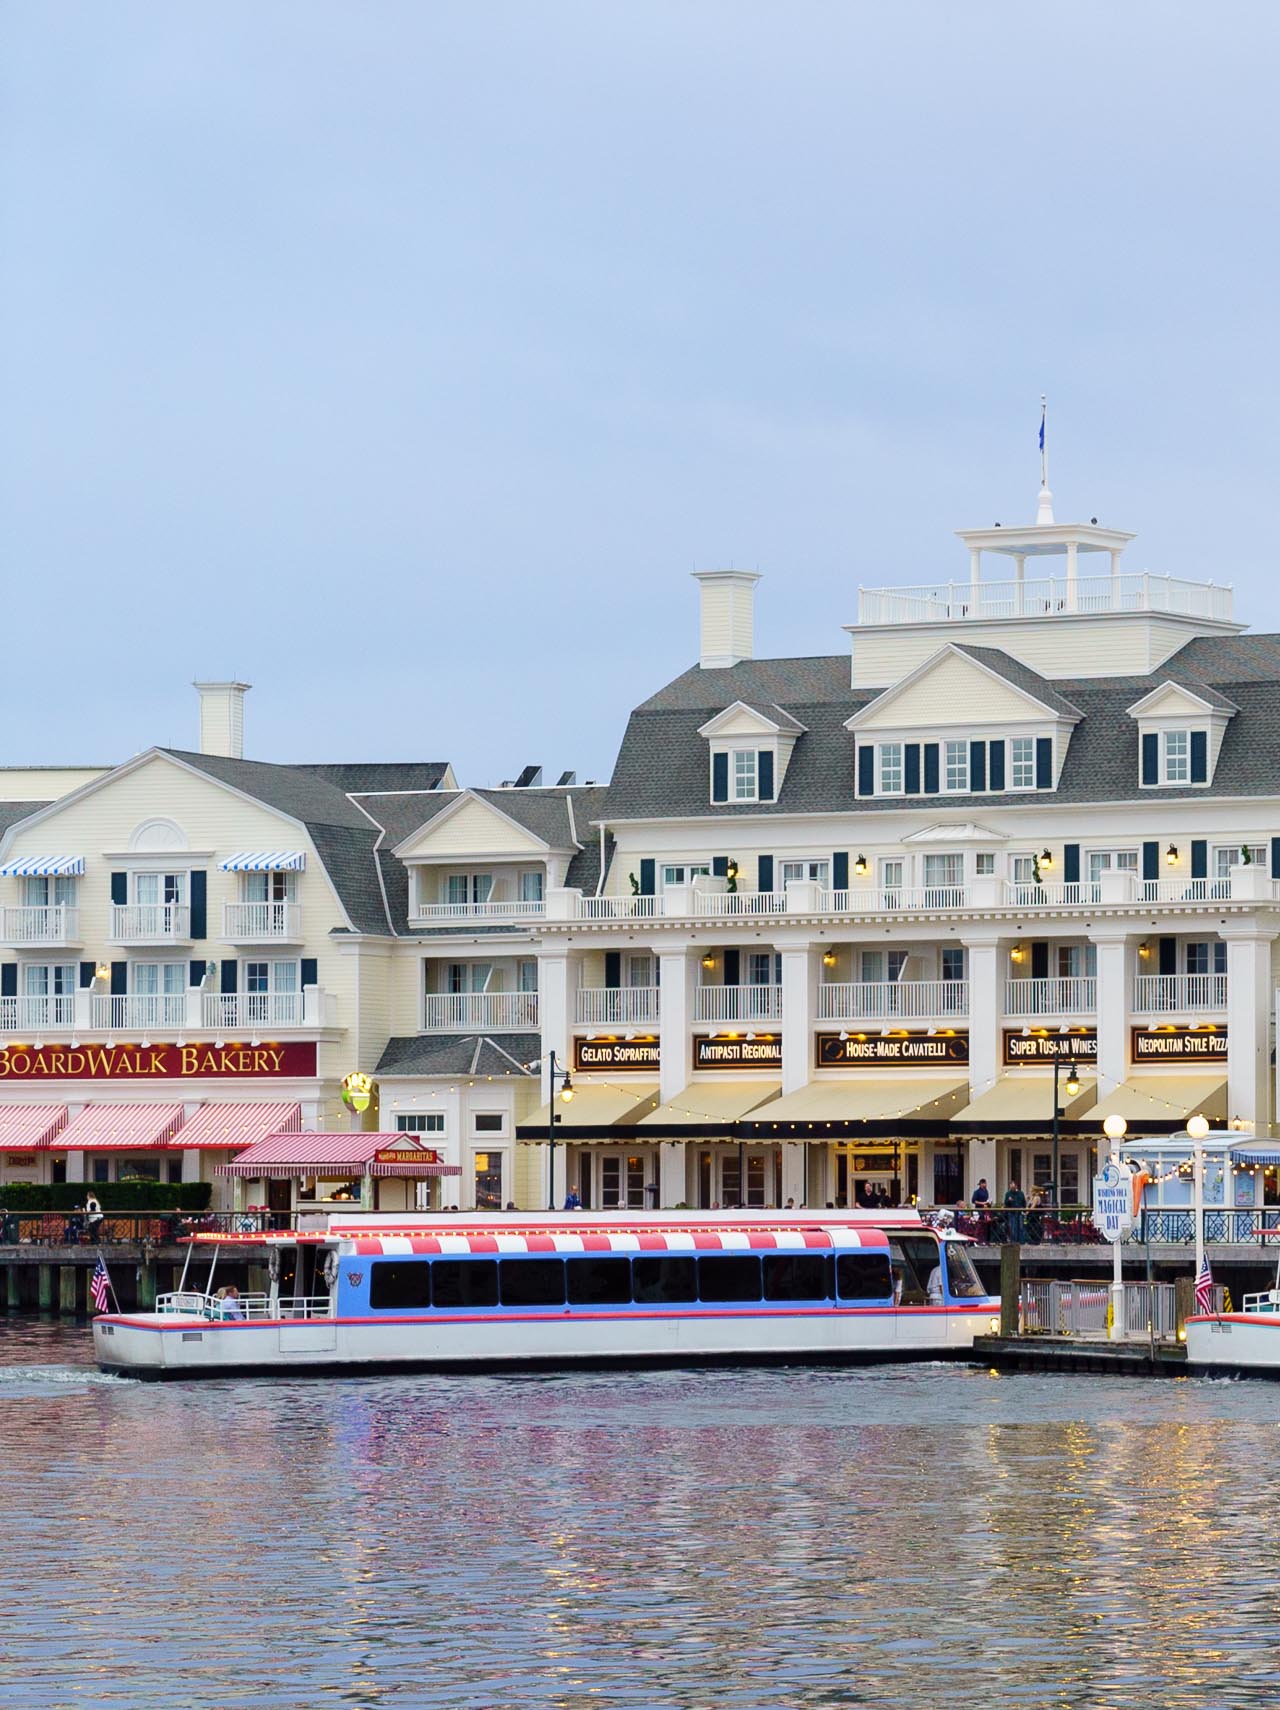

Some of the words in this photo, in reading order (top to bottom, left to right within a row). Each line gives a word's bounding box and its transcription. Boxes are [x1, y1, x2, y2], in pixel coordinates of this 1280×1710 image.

[700, 1044, 740, 1060] ANTIPASTI
[846, 1041, 900, 1057] HOUSE-MADE
[901, 1041, 946, 1057] CAVATELLI
[1010, 1038, 1037, 1055] SUPER
[1071, 1037, 1097, 1054] WINES
[1138, 1036, 1183, 1053] NEOPOLITAN
[1184, 1035, 1207, 1053] STYLE
[581, 1046, 612, 1062] GELATO
[613, 1046, 661, 1061] SOPRAFFINO
[0, 1049, 167, 1077] BOARDWALK
[181, 1048, 285, 1075] BAKERY
[397, 1150, 433, 1162] MARGARITAS
[1097, 1199, 1127, 1214] MAGICAL
[1106, 1215, 1119, 1230] DAY
